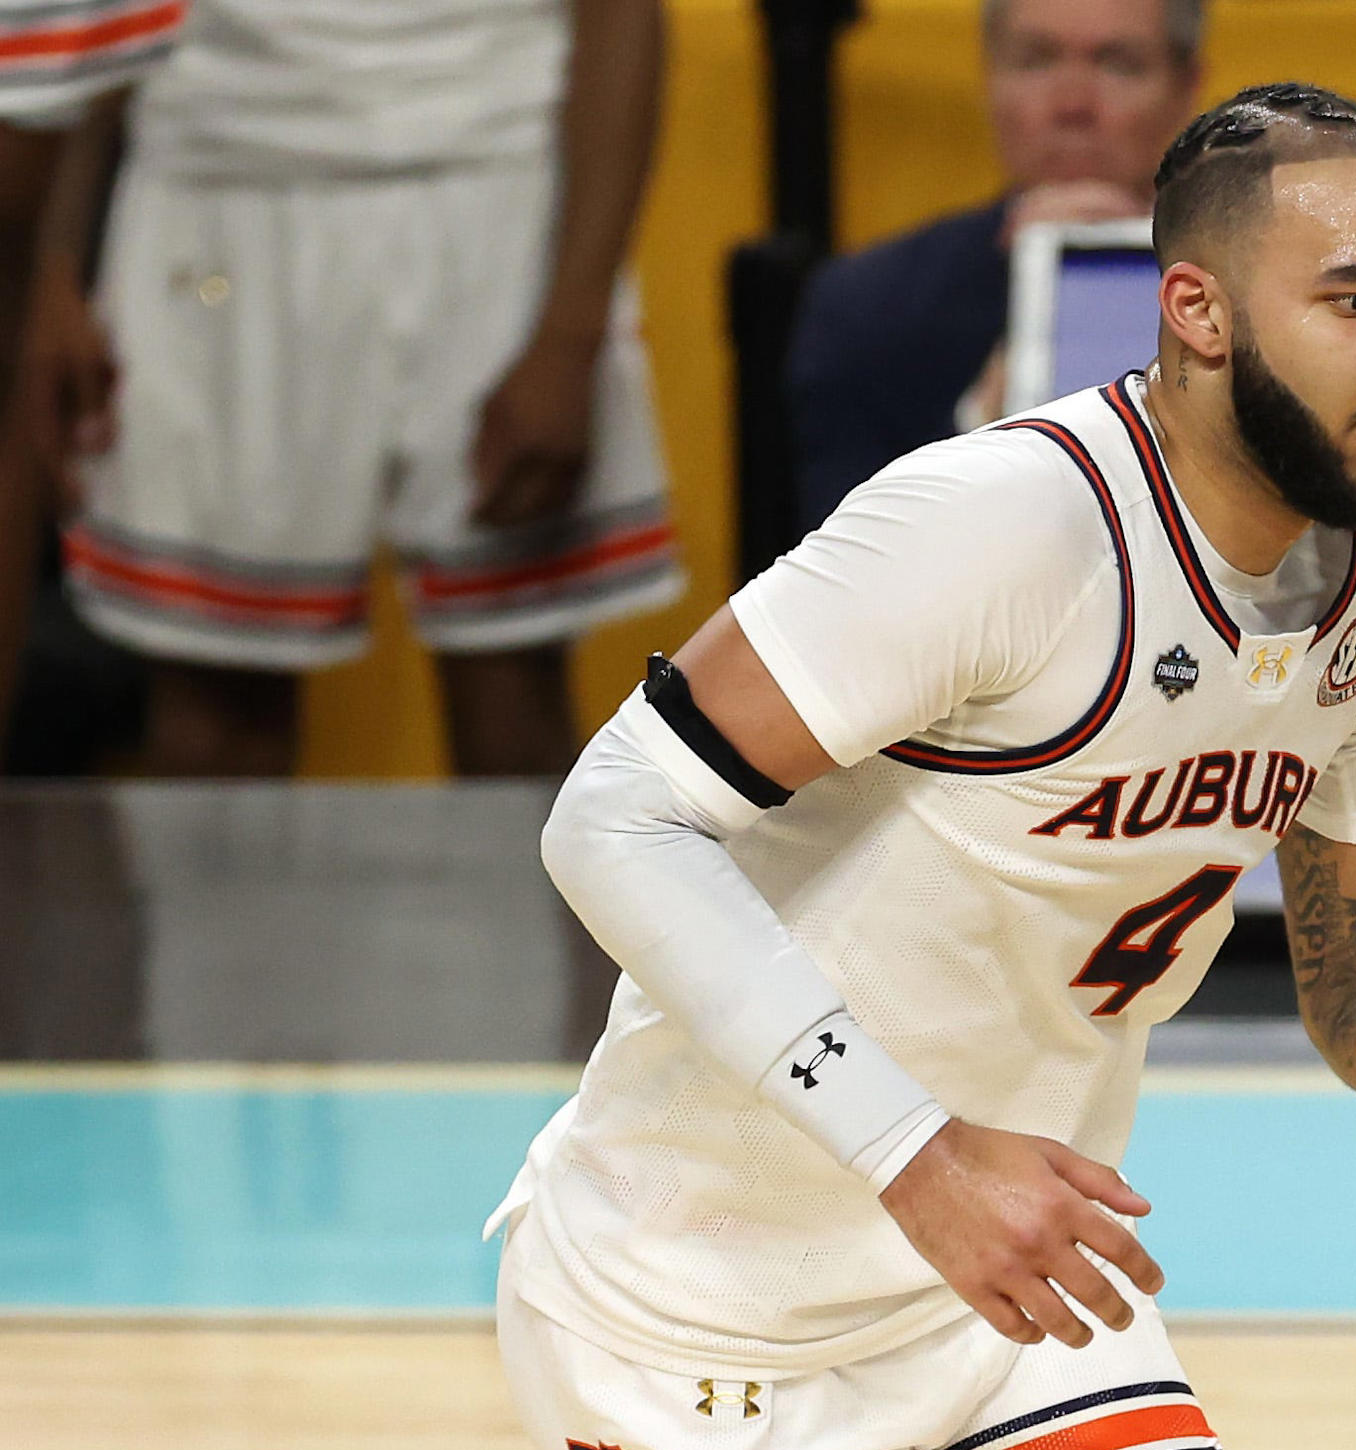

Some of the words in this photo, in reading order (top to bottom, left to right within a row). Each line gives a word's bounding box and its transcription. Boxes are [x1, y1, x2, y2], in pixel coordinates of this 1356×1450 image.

[1156, 662, 1177, 678] FINAL
[1176, 665, 1198, 681] FOUR
[1069, 864, 1243, 1016] 4
